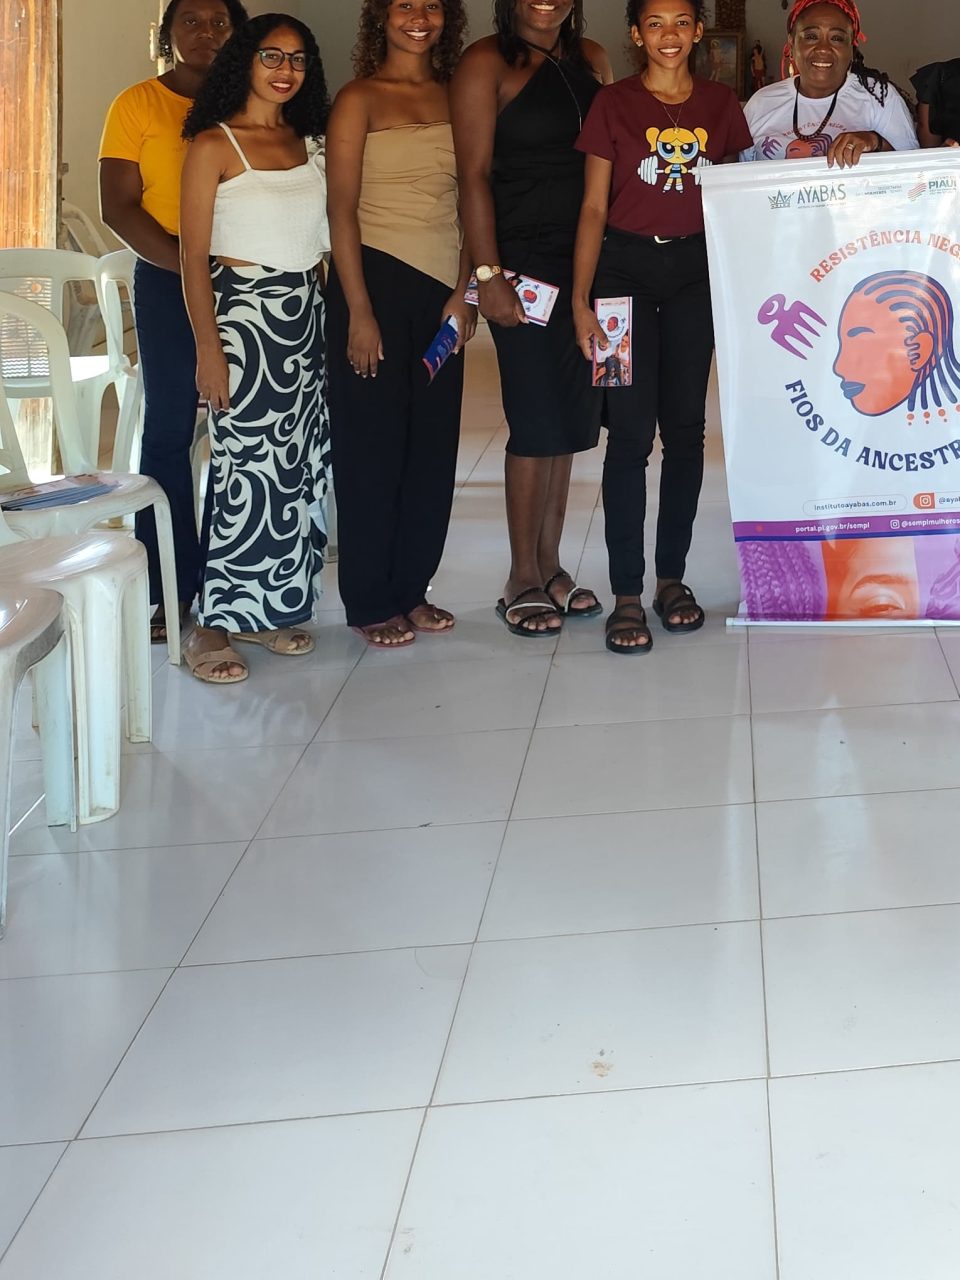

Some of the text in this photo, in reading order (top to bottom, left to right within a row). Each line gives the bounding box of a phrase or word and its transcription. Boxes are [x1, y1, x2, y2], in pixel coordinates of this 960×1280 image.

[810, 229, 922, 283] RESISTÊNCIA
[785, 378, 825, 432] FIOS
[820, 426, 852, 457] DA
